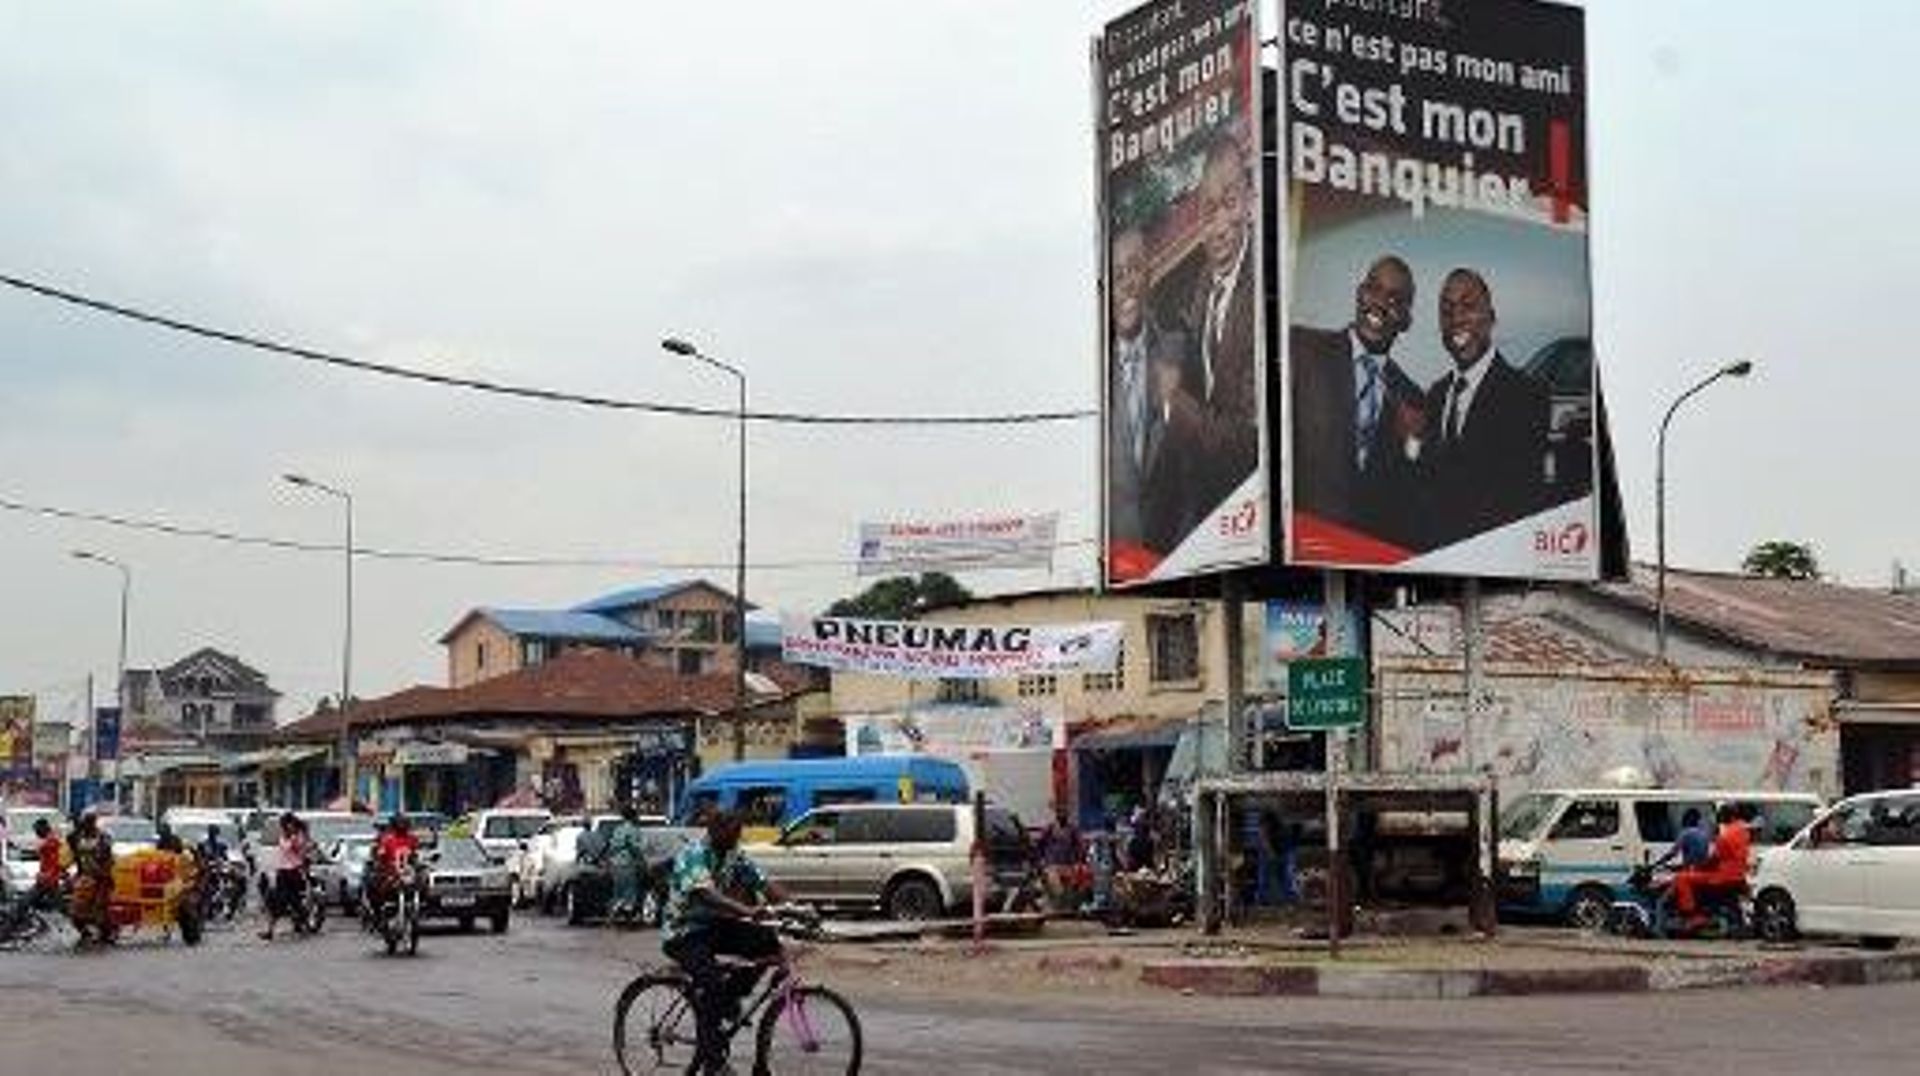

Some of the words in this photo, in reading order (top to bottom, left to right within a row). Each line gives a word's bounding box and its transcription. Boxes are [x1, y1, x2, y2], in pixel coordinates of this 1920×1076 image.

[1289, 18, 1316, 45] ce
[1325, 24, 1394, 60] n'est
[1400, 42, 1447, 74] pas
[1455, 54, 1514, 86] mon
[1519, 63, 1571, 94] ami
[1291, 58, 1407, 134] C'est
[1422, 99, 1525, 153] mon
[814, 620, 1031, 652] PNEUMAG
